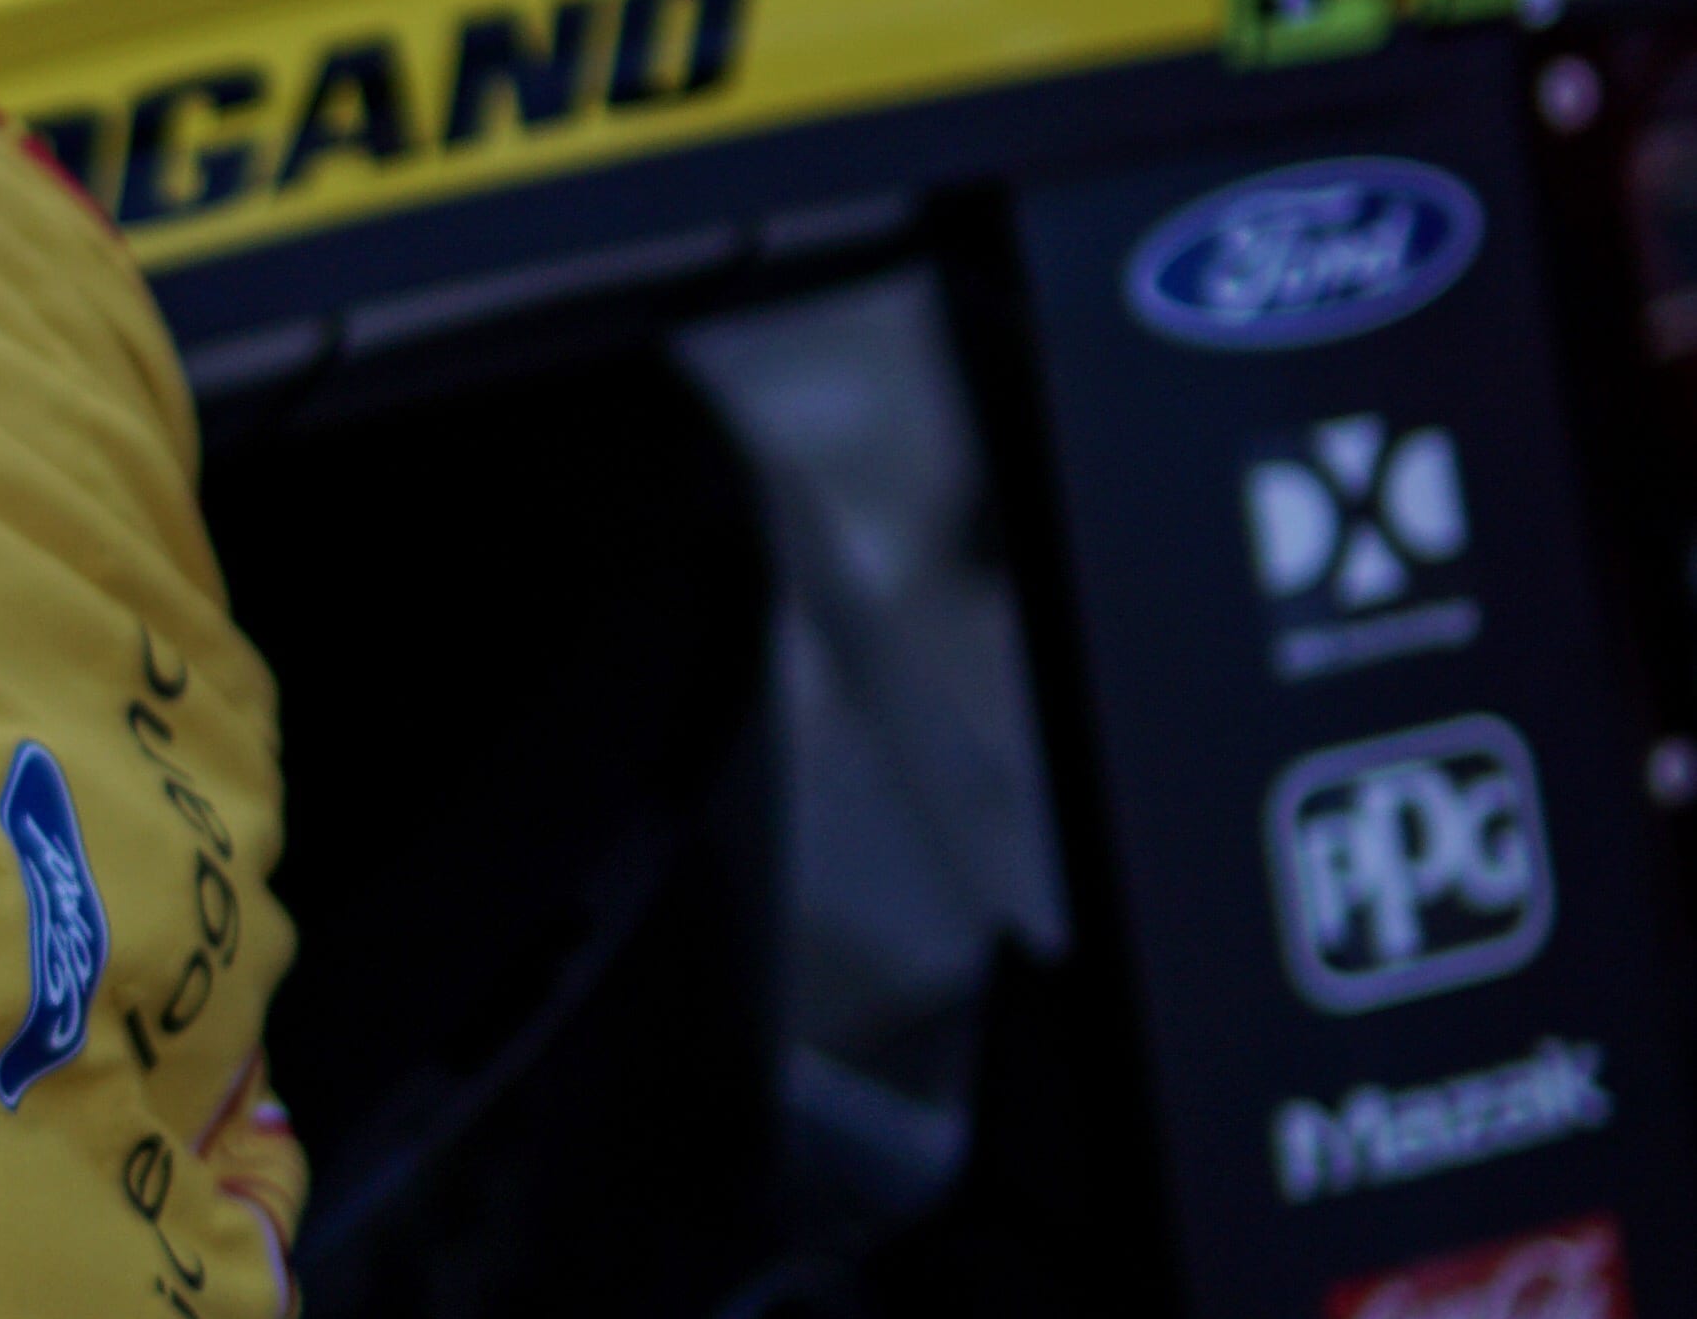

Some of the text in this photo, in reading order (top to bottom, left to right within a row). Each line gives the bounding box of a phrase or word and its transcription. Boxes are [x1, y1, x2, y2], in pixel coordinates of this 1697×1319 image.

[1197, 178, 1423, 325] Ford
[1293, 756, 1535, 968] PPG
[1269, 1034, 1619, 1206] Mazak
